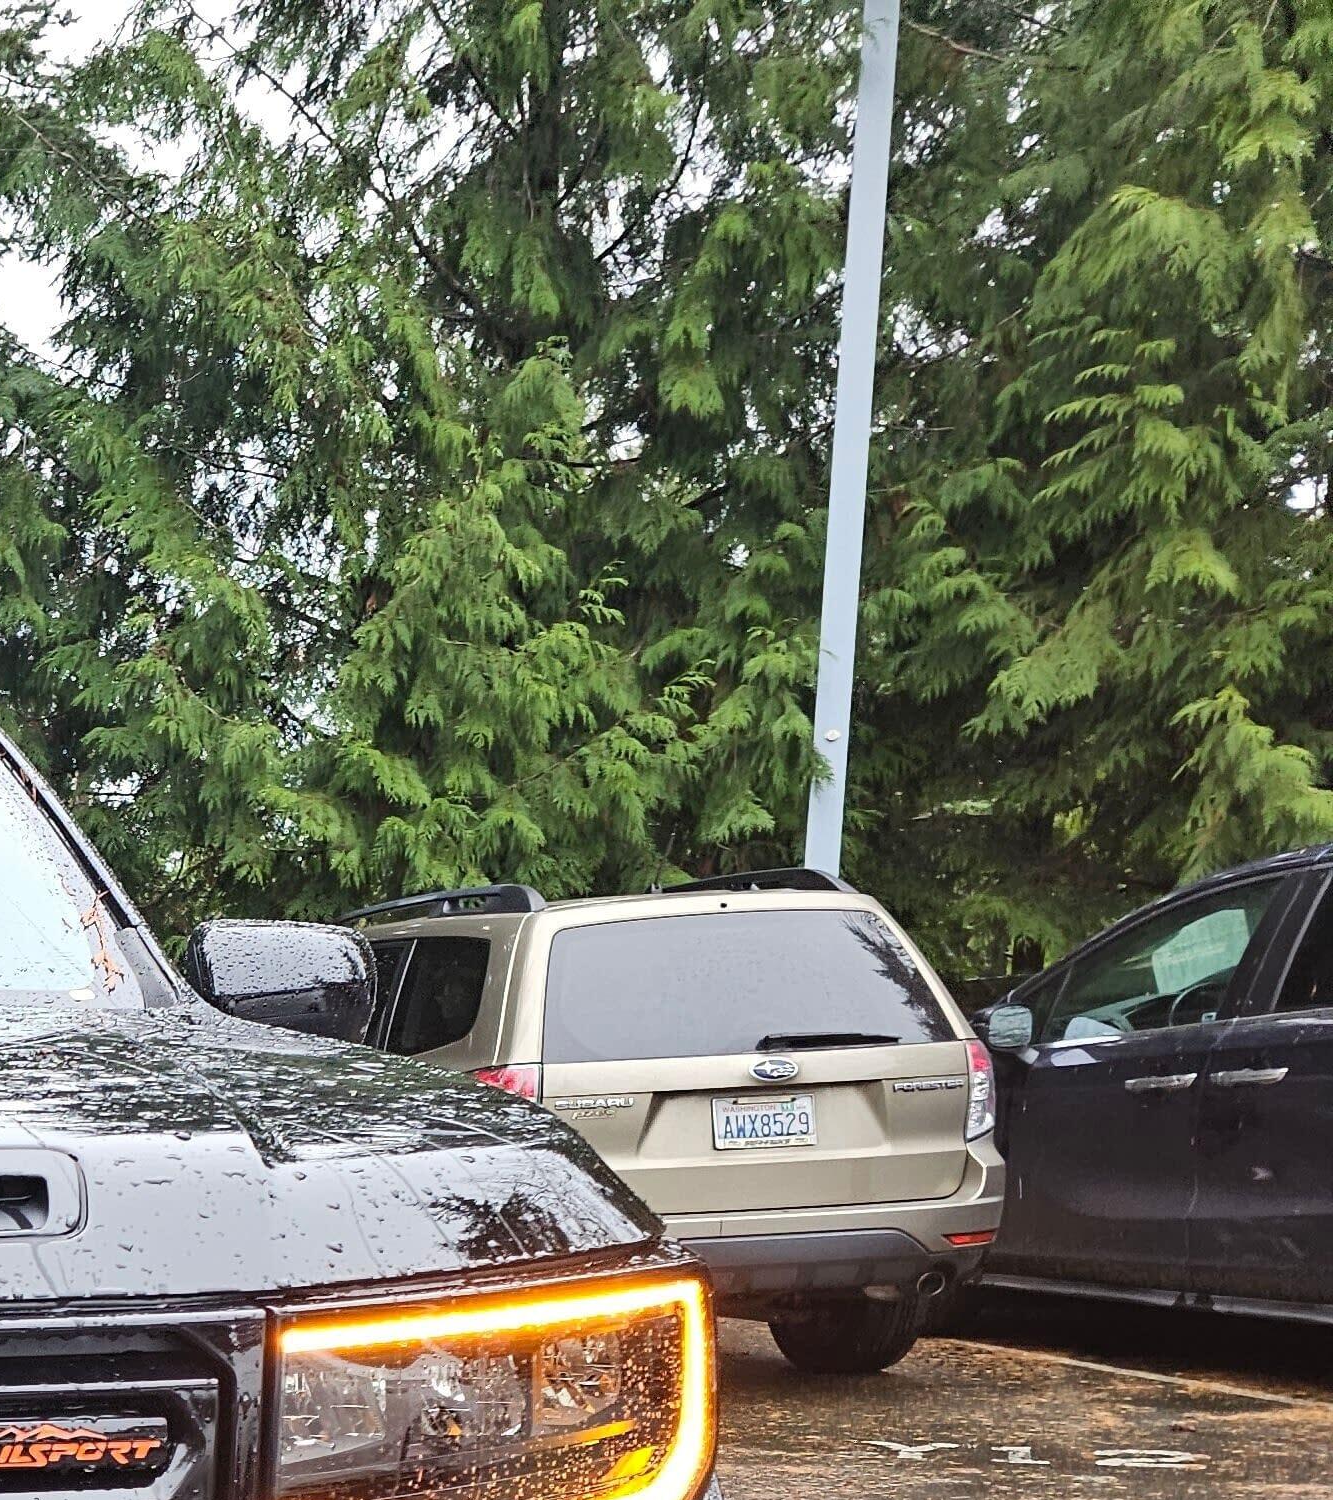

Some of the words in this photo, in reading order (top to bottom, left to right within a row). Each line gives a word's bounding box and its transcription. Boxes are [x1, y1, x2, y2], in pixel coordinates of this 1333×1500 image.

[893, 1079, 964, 1092] FORESTER
[555, 1097, 634, 1110] SUBARU
[722, 1104, 776, 1113] WASHINGTON
[724, 1112, 810, 1139] AWX8529
